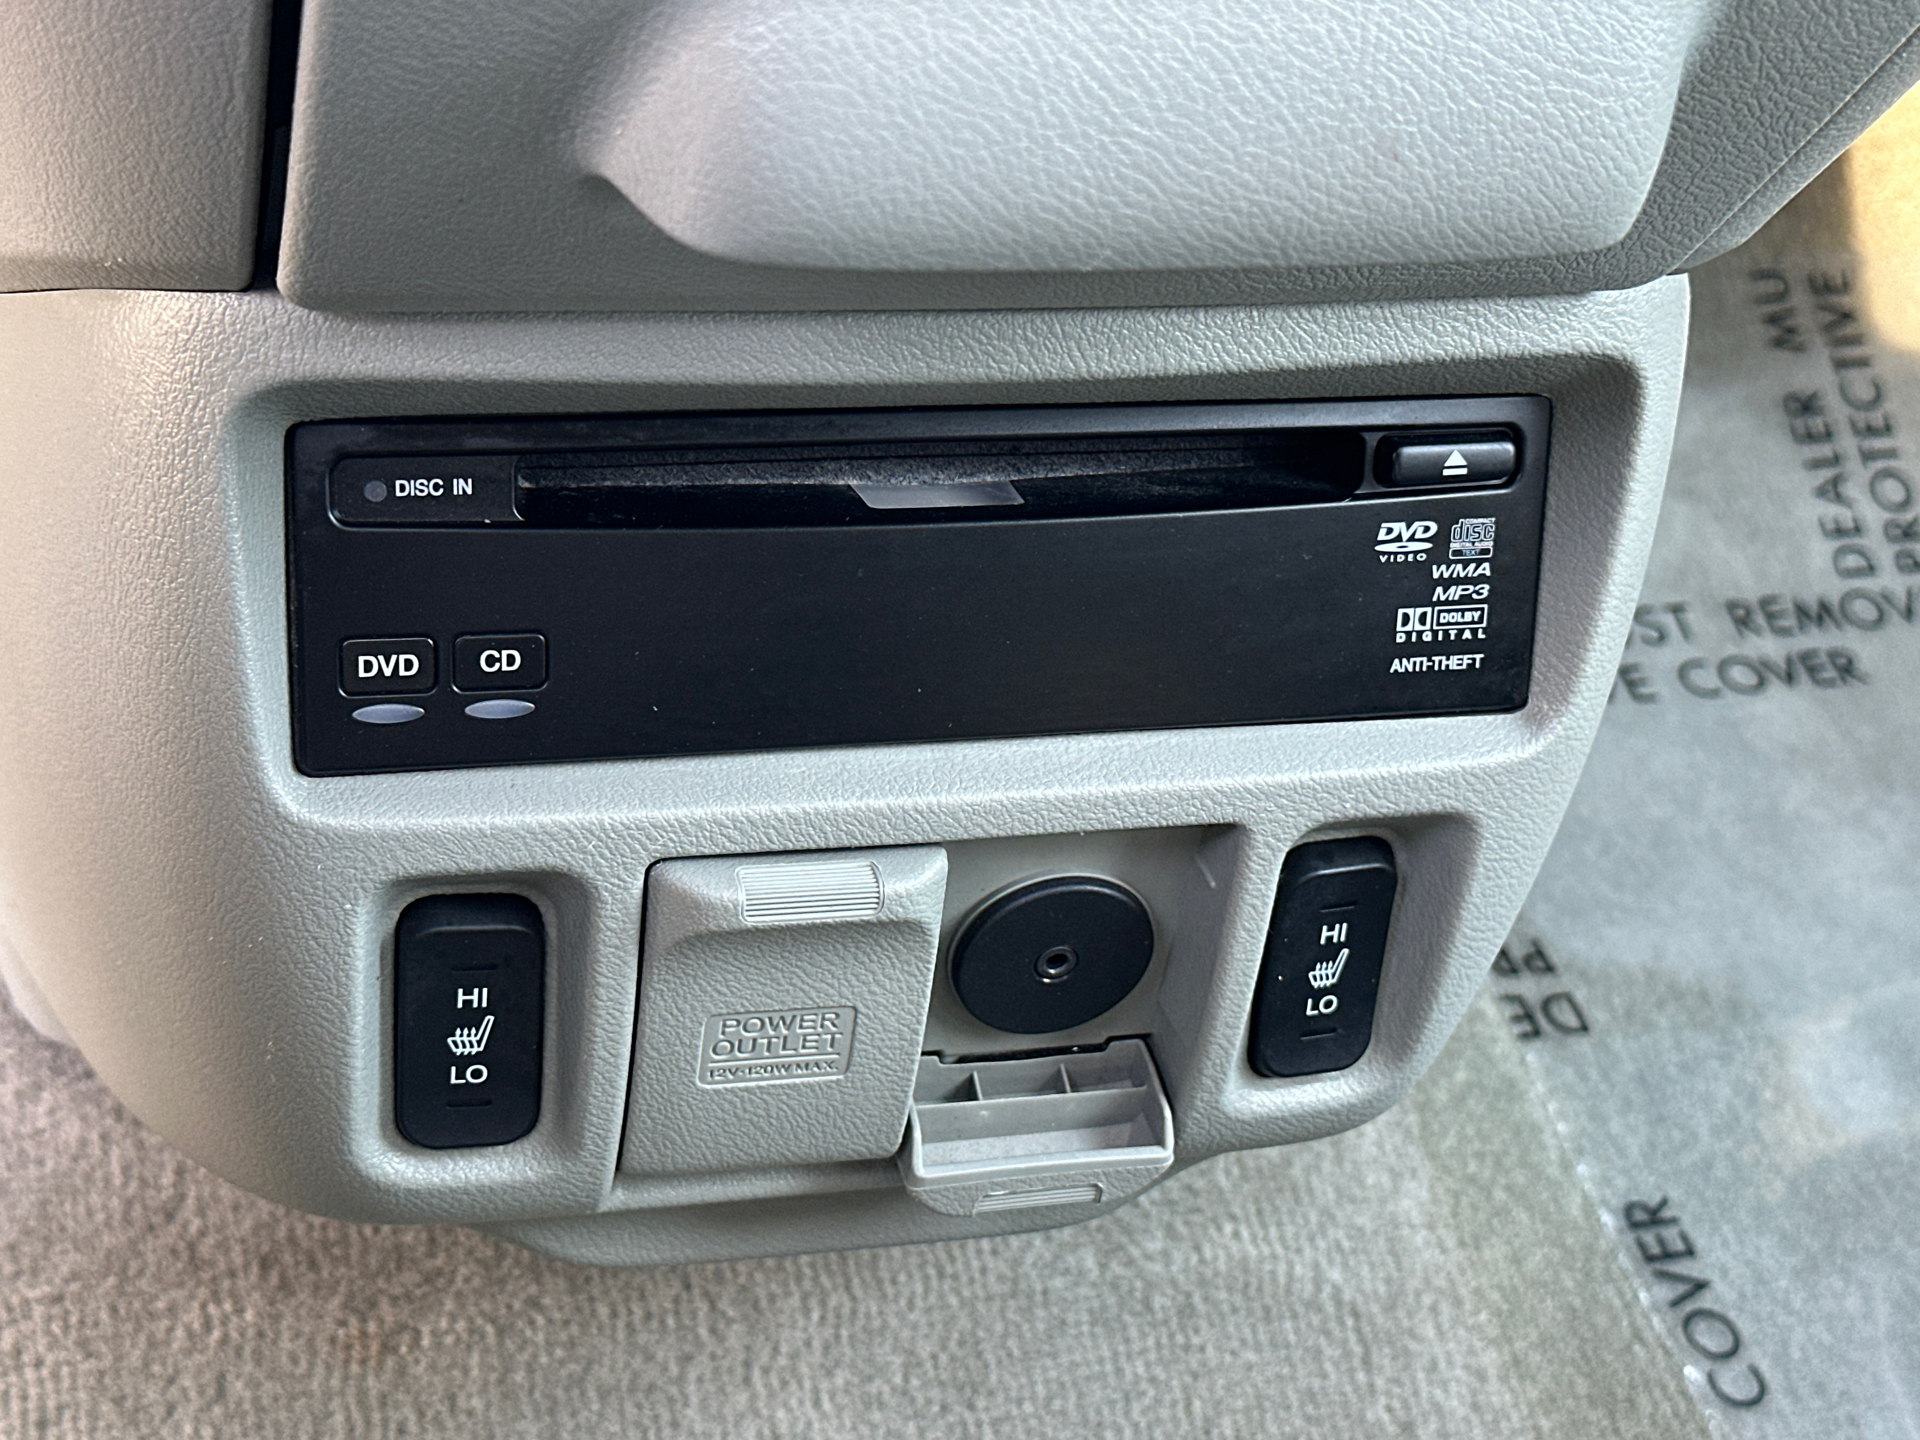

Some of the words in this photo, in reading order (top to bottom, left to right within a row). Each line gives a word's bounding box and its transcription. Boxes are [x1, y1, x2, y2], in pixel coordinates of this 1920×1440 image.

[394, 478, 445, 497] DISC
[453, 478, 474, 496] IN
[1783, 388, 1876, 579] DEALER
[1377, 521, 1439, 542] DVD
[1379, 552, 1428, 563] VIDEO
[1432, 562, 1491, 579] WMA
[1432, 584, 1490, 602] MP3
[1439, 611, 1482, 624] DOLBY
[1623, 601, 1690, 649] ST
[1395, 628, 1487, 643] DIGITAL
[358, 653, 420, 678] DVD
[479, 650, 522, 673] CD
[1389, 654, 1485, 674] ANTI-THEFT
[1677, 646, 1870, 699] COVER
[1320, 922, 1349, 945] HI
[457, 987, 489, 1009] HI
[1305, 995, 1339, 1017] LO
[719, 1011, 841, 1038] POWER
[710, 1032, 844, 1059] OUTLET
[450, 1064, 488, 1084] LO
[1622, 1194, 1768, 1408] COVER
